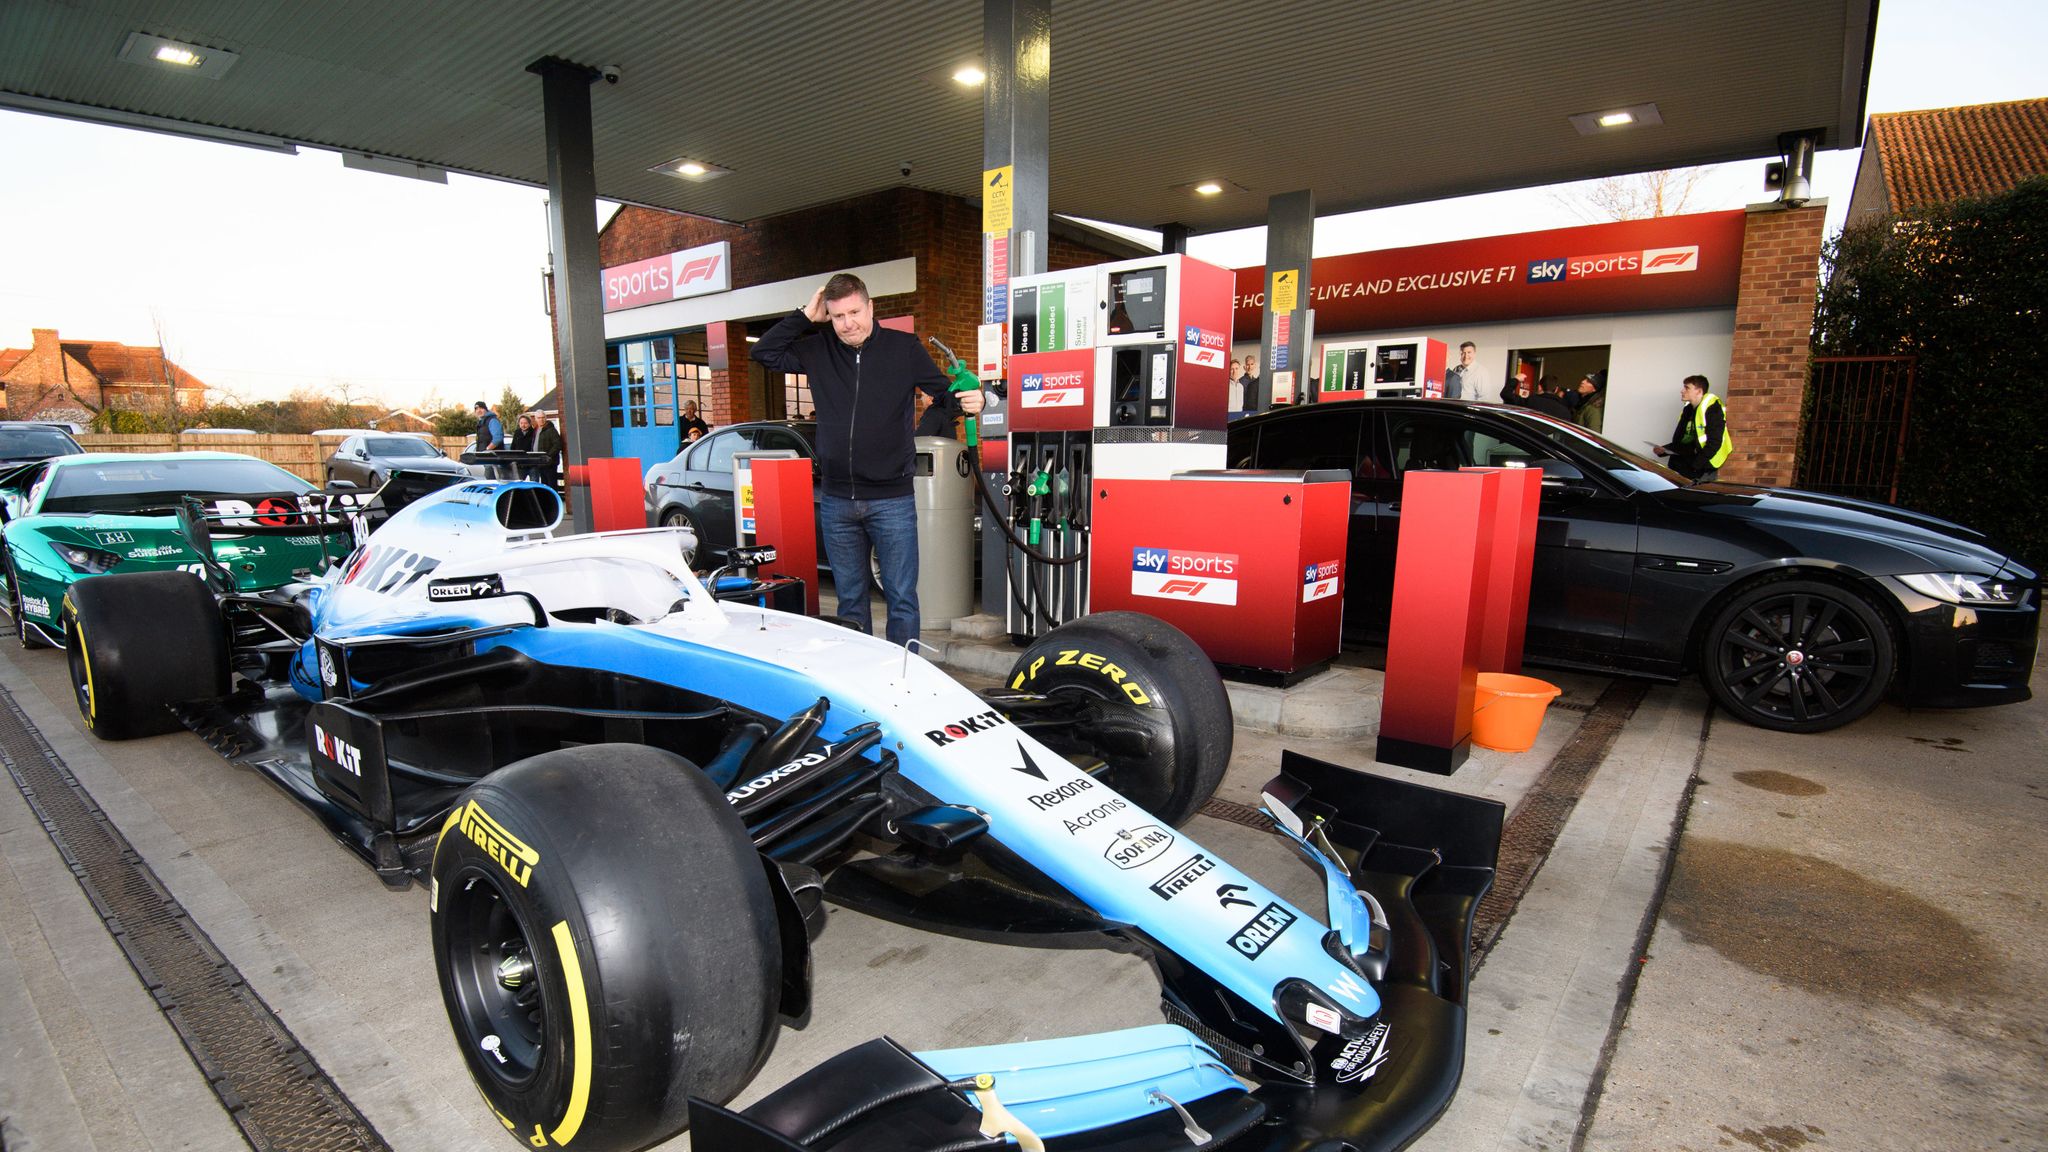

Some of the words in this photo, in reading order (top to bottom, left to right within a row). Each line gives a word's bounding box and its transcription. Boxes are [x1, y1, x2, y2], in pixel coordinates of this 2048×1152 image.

[991, 190, 1006, 199] CCTV
[609, 264, 669, 305] sports
[1531, 261, 1565, 281] sky
[1570, 255, 1639, 278] sports
[1242, 293, 1265, 309] HO
[1317, 282, 1352, 301] LIVE
[1352, 278, 1393, 297] AND
[1395, 267, 1494, 293] EXCLUSIVE
[1496, 265, 1517, 283] F1
[1048, 305, 1056, 350] Unleaded
[1187, 328, 1200, 345] sky
[1201, 332, 1224, 348] sports
[1023, 375, 1042, 390] sky
[1044, 373, 1082, 389] sports
[1137, 549, 1166, 572] sky
[1171, 554, 1234, 575] sports
[1305, 566, 1318, 582] sky
[1318, 563, 1338, 579] sports
[24, 601, 51, 616] HYBRID
[432, 586, 469, 597] ORLEN
[1029, 655, 1046, 681] P
[1055, 649, 1151, 705] ZERO
[1027, 778, 1094, 812] Rexona
[1062, 798, 1127, 836] Acronis
[459, 799, 540, 889] PIRELLI
[1114, 830, 1169, 865] SOFINA
[1148, 853, 1217, 902] PIRELLI
[1235, 905, 1292, 954] ORLEN
[1328, 970, 1367, 1003] W
[1344, 1061, 1358, 1073] FOR
[1352, 1044, 1372, 1064] ROAD
[1364, 1022, 1388, 1047] SAFETY
